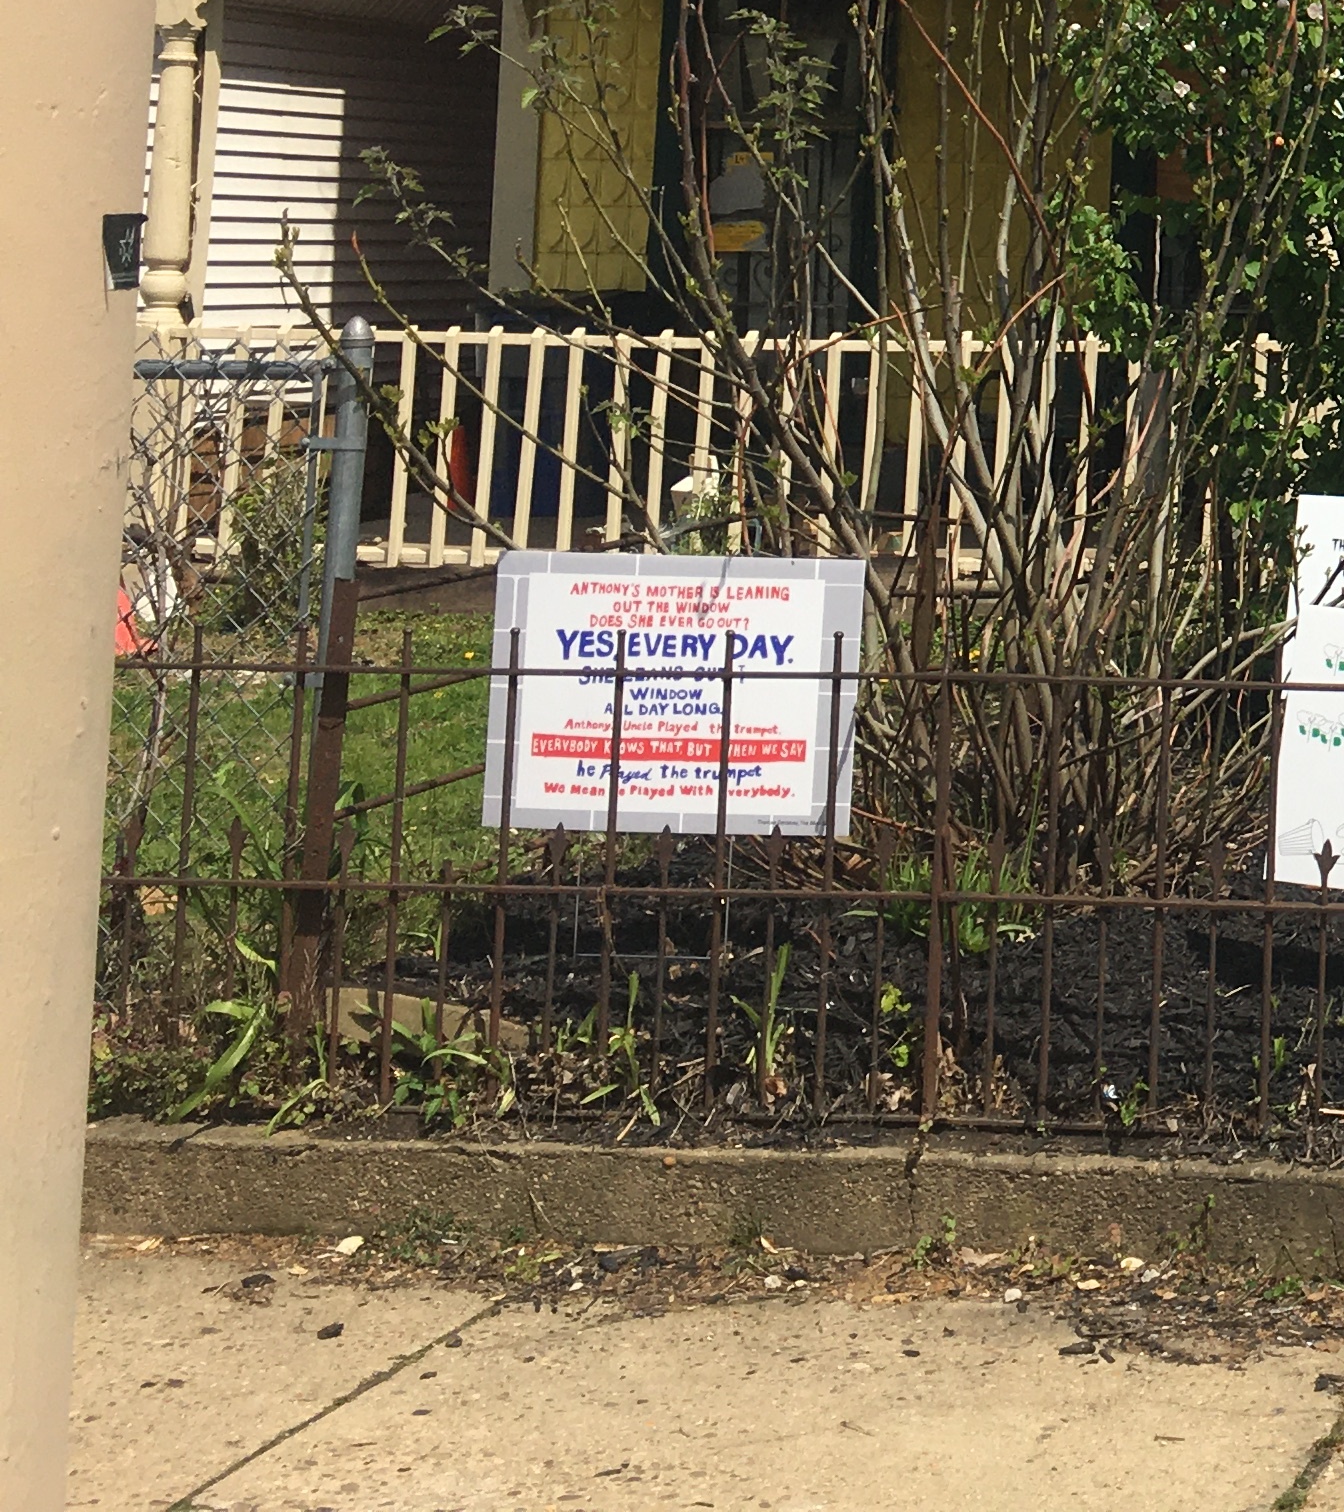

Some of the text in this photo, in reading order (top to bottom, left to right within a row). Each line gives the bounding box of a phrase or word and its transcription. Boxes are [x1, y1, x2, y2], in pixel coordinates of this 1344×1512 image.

[570, 582, 640, 598] ANTHONY'S
[646, 584, 702, 598] MOTHER
[727, 586, 790, 601] LEANING
[613, 601, 731, 613] OUT THE WINDOW
[590, 614, 749, 630] DOES SHE EVER GO OUT?
[627, 633, 717, 661] EVERY
[731, 634, 794, 665] DAY.
[629, 688, 703, 701] WINDOW
[604, 702, 633, 715] AL
[639, 703, 669, 715] DAY
[623, 721, 653, 731] Uncle
[657, 721, 699, 736] Played
[709, 723, 721, 734] th
[603, 740, 644, 755] KOWS
[687, 742, 712, 757] BUT
[762, 744, 778, 756] WE
[780, 743, 804, 758] SAY
[577, 760, 595, 777] he
[600, 763, 652, 785] Payed
[544, 782, 565, 795] We
[570, 784, 605, 797] Mean
[630, 784, 674, 800] Played
[680, 784, 713, 797] With
[728, 786, 795, 800] verybody.
